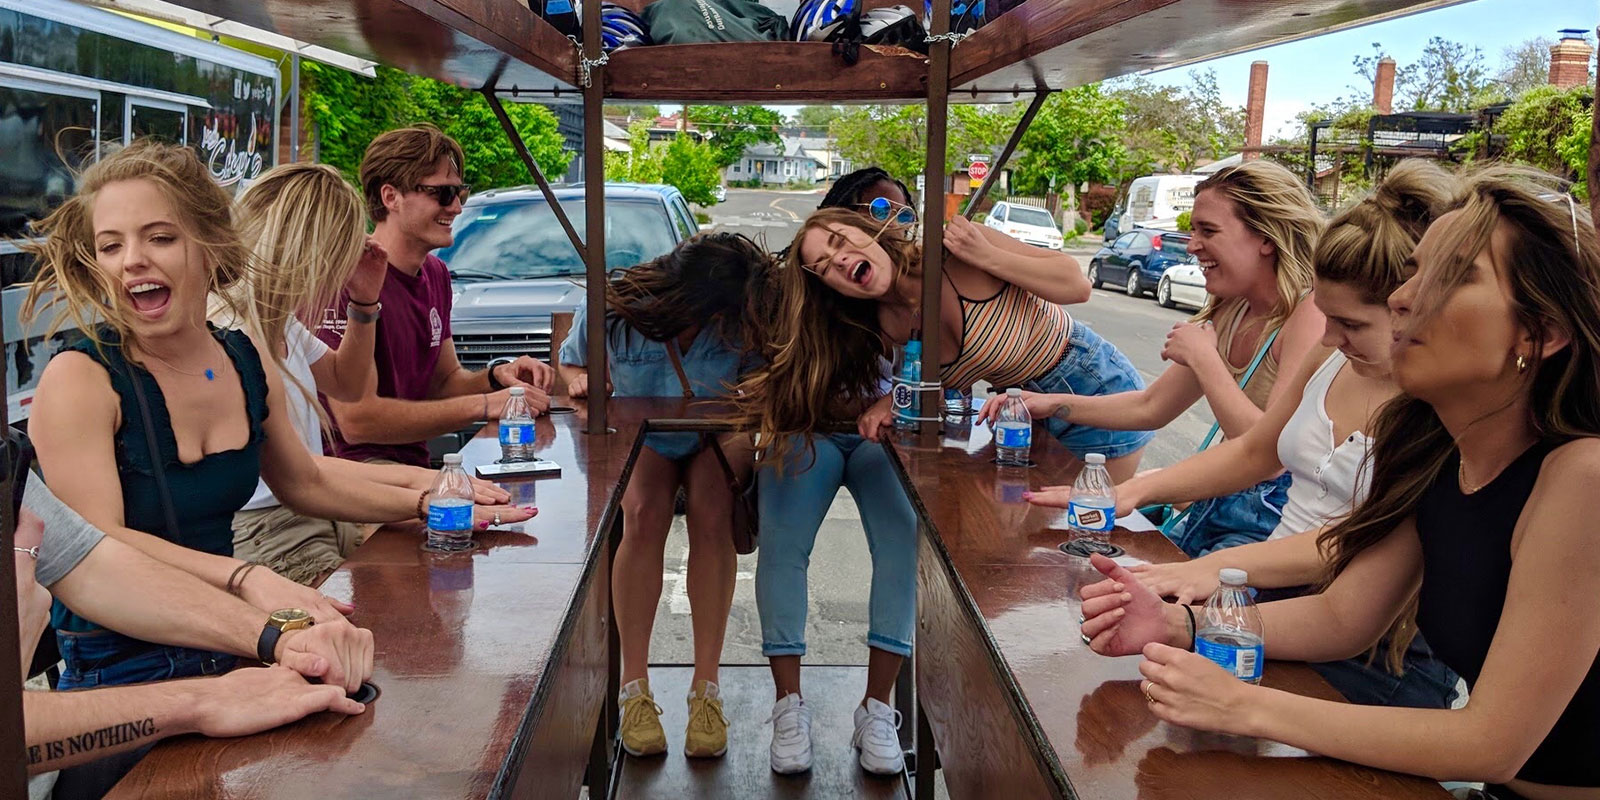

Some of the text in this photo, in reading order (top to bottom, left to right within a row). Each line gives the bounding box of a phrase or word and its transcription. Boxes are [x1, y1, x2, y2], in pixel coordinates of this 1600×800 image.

[970, 166, 987, 175] STOP
[27, 718, 160, 764] E IS NOTHING.
